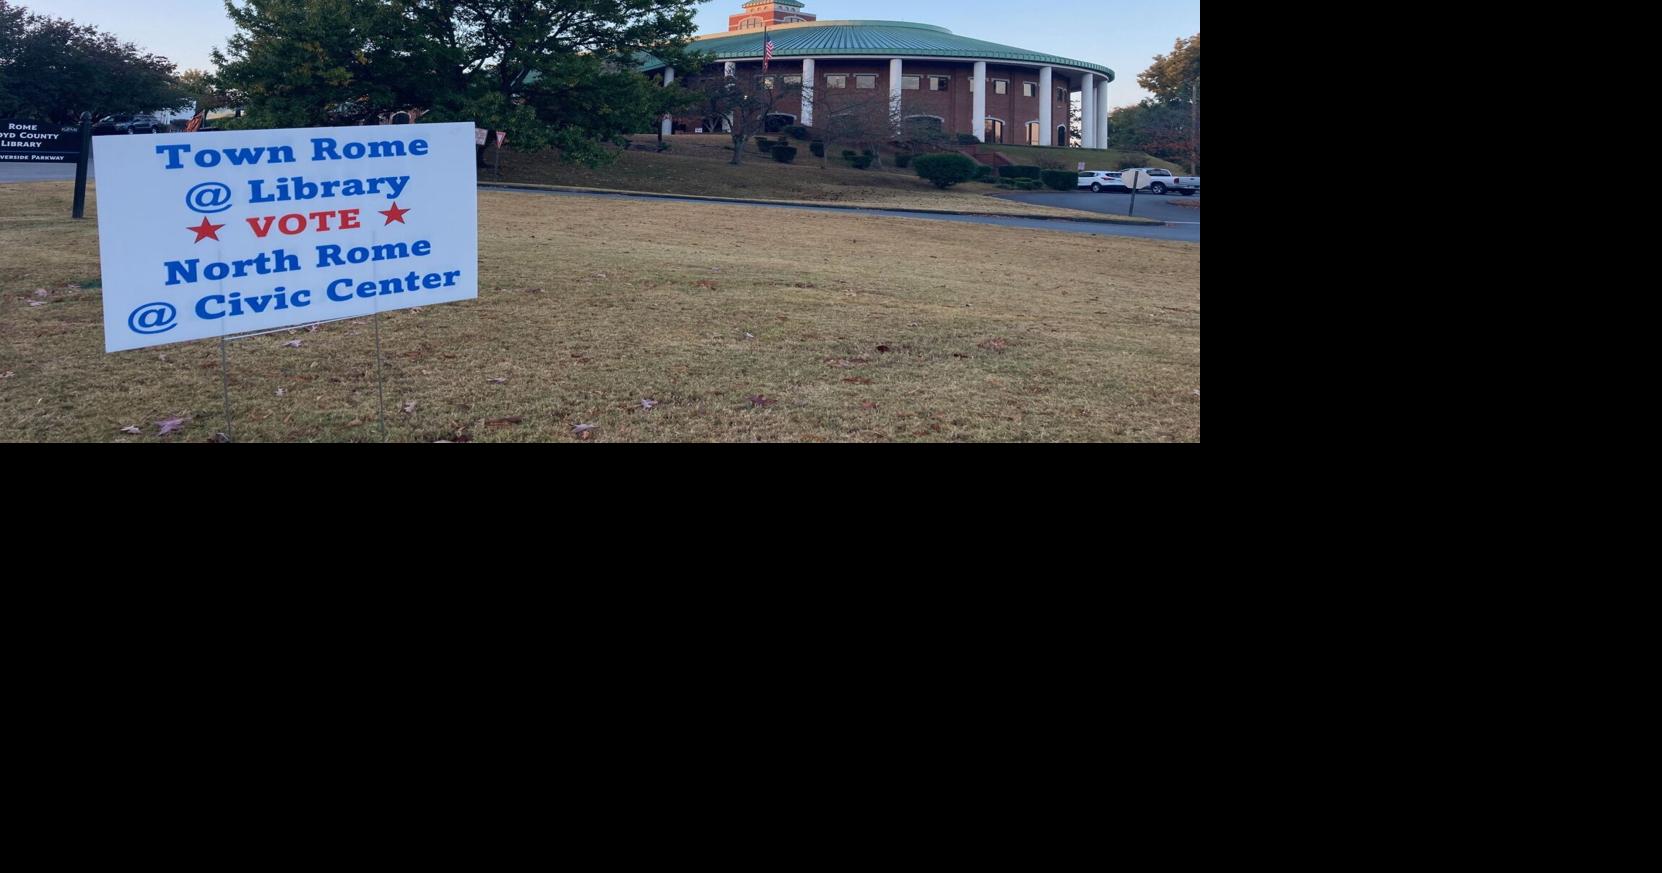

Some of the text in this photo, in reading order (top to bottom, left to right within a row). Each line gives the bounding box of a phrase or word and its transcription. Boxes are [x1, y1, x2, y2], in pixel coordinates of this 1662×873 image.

[8, 123, 38, 131] ROME
[20, 132, 59, 140] COUNTY
[1, 139, 42, 148] LIBRARY
[155, 137, 429, 170] Town Rome
[185, 174, 411, 214] @ Library
[246, 207, 361, 239] VOTE
[163, 239, 432, 286] North Rome
[127, 268, 461, 335] @ Civic Center
